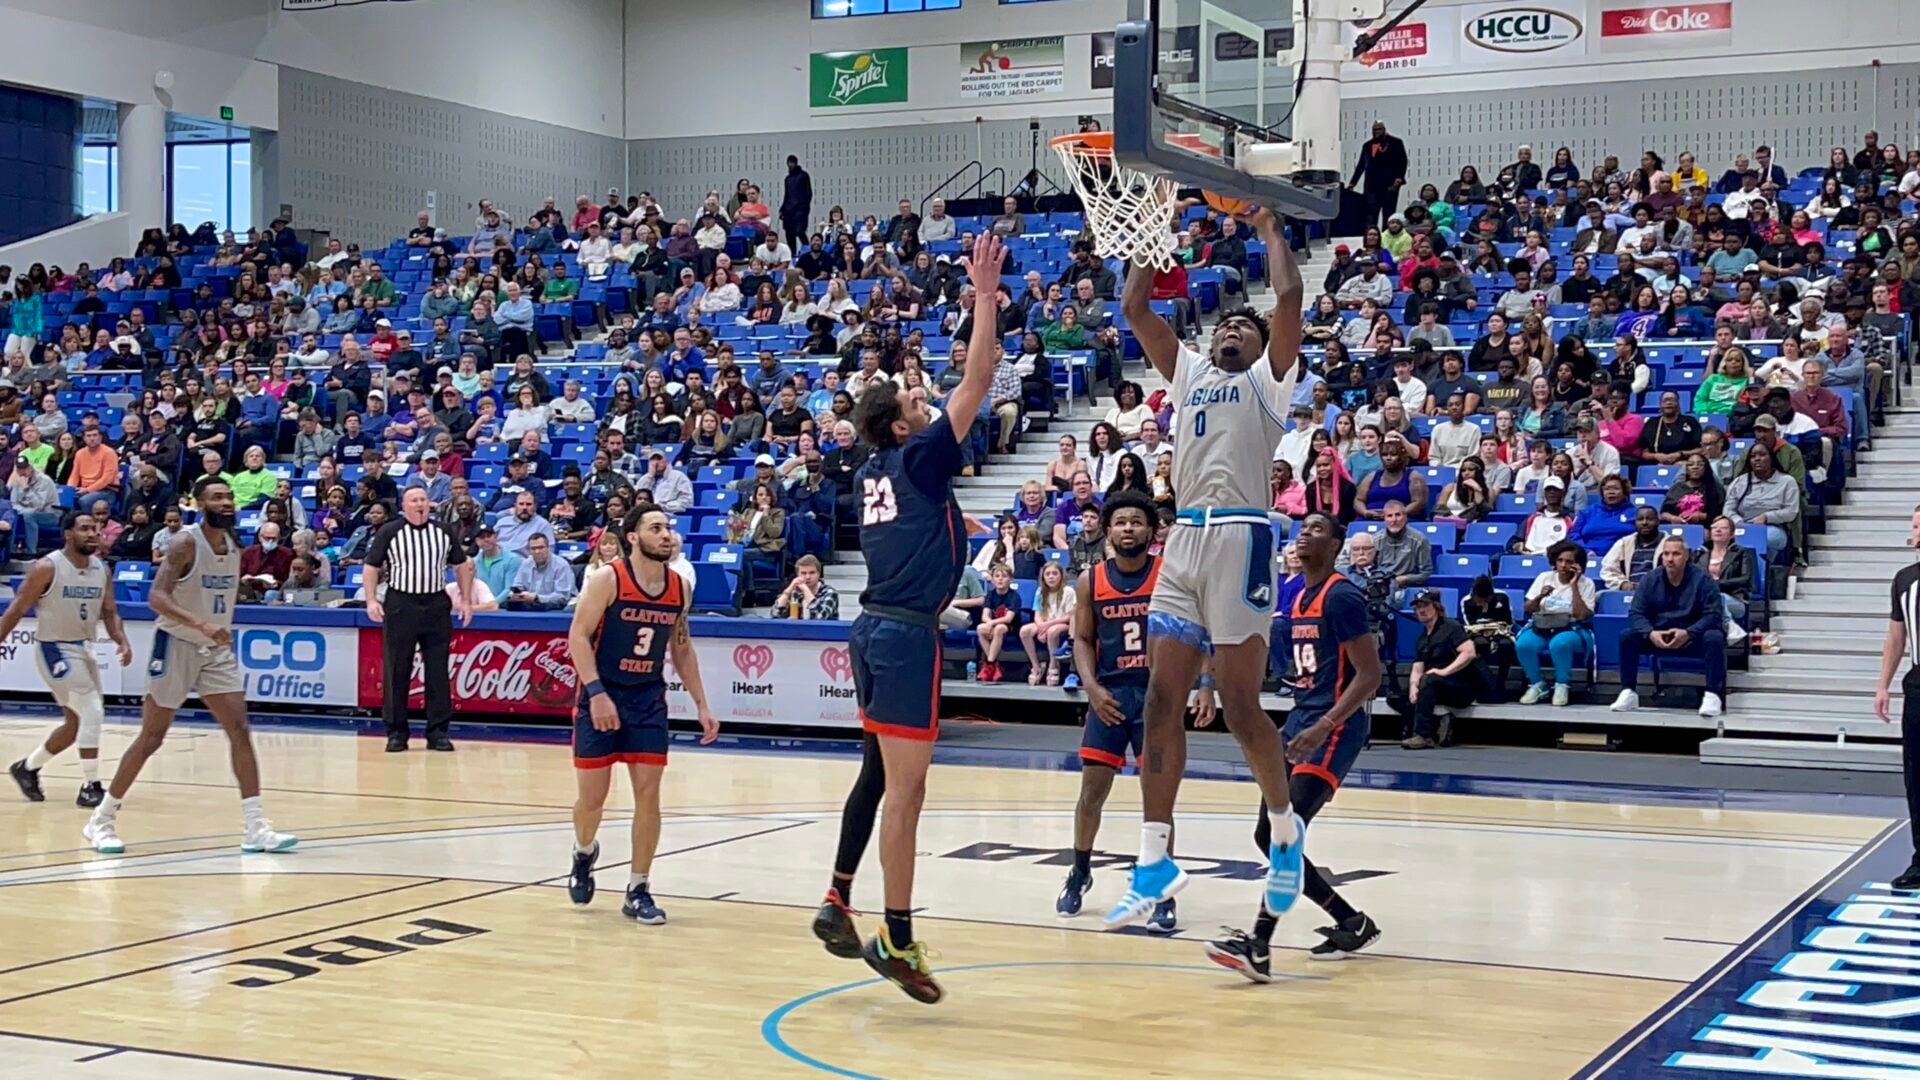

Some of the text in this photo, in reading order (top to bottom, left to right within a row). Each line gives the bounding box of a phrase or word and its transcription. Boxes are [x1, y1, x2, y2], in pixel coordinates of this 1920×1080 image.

[1476, 13, 1551, 39] HCCU
[1620, 7, 1710, 32] Diet Coke
[1383, 29, 1412, 41] ILLIE
[835, 62, 882, 98] Sprite
[961, 78, 1063, 91] ROLLING OUT THE RED CARPET
[1195, 410, 1206, 438] 0
[863, 475, 898, 526] 23
[213, 594, 227, 615] 13
[1101, 602, 1149, 620] CLAYTO
[620, 607, 678, 626] CLAYTON
[633, 626, 656, 657] 3
[1122, 621, 1143, 652] 2
[618, 657, 655, 673] STATE
[257, 673, 326, 699] Office
[732, 681, 774, 696] iHeart
[819, 684, 857, 699] iHear
[732, 707, 774, 718] AUGUSTA
